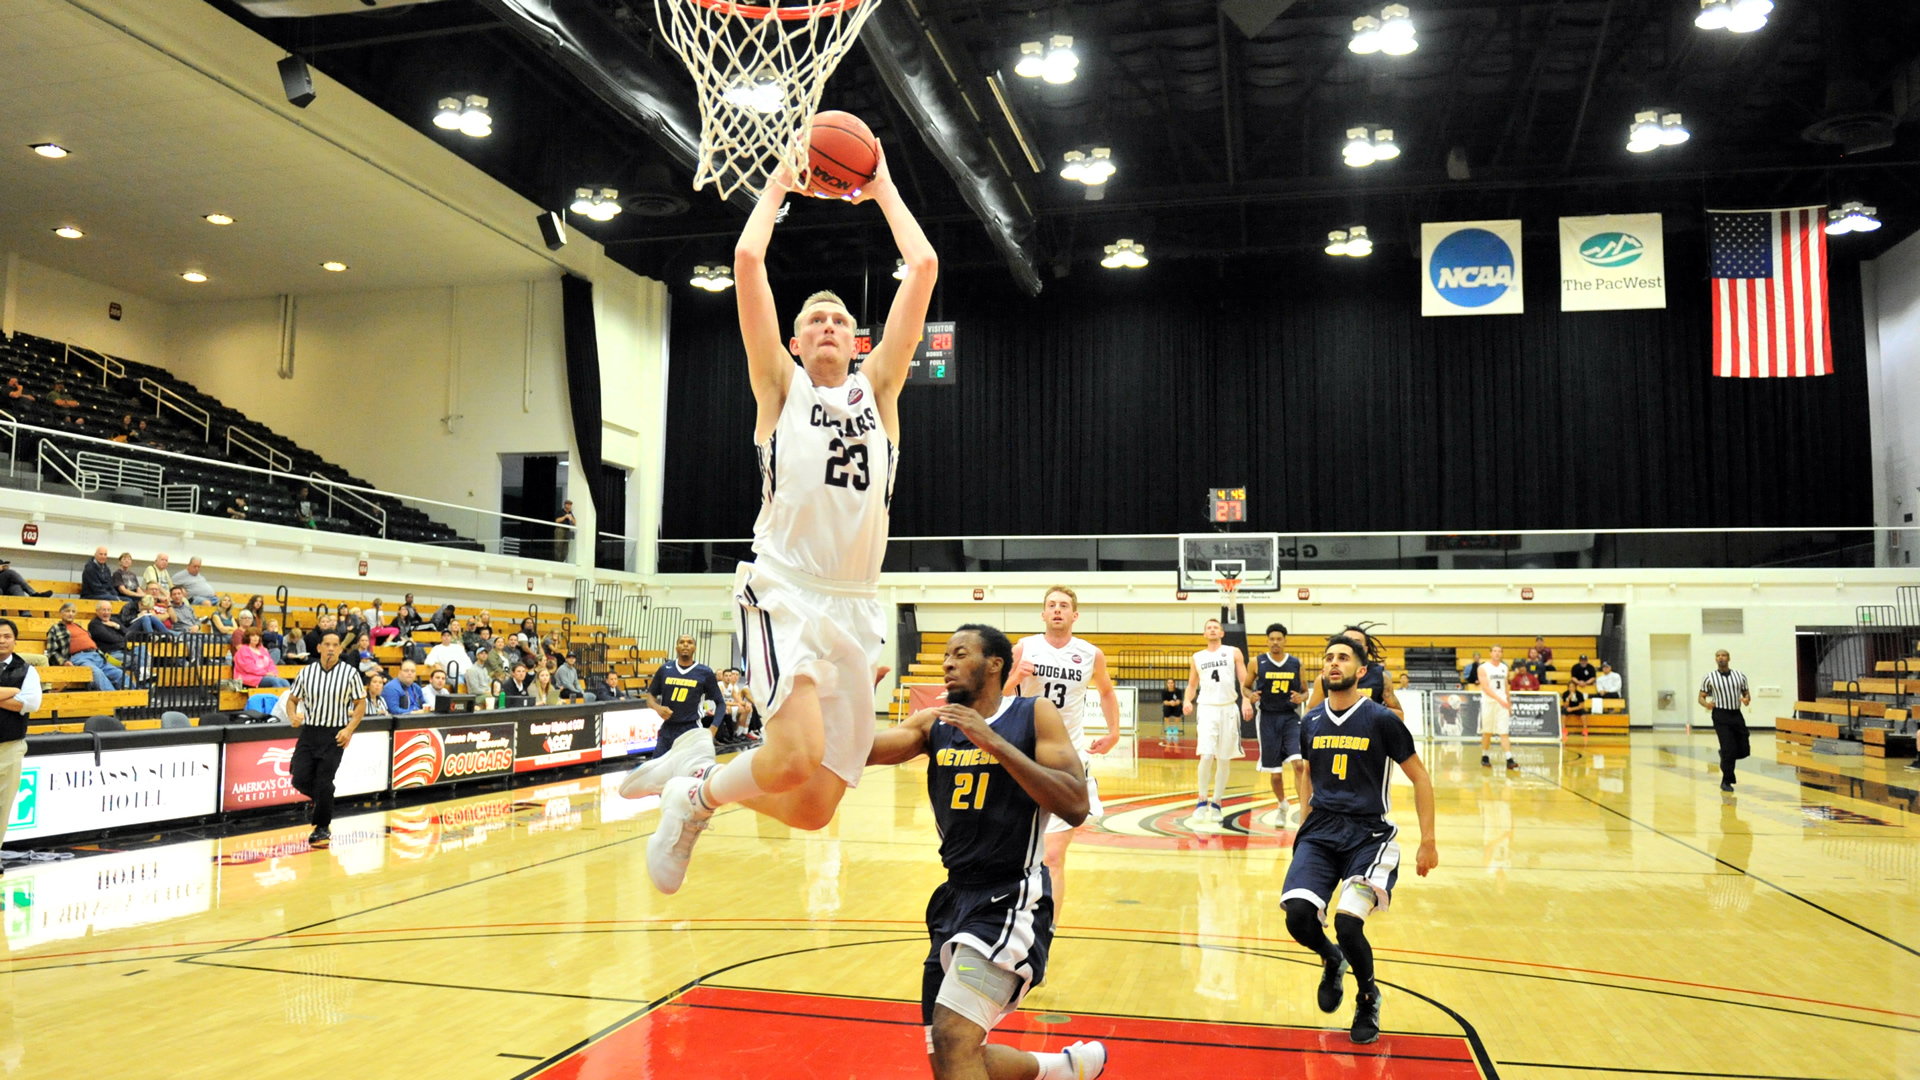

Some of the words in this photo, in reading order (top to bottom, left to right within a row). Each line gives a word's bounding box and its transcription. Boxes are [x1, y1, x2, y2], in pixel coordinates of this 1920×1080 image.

[813, 165, 853, 191] NCAA
[1437, 265, 1512, 289] NCAA
[1563, 279, 1592, 291] The
[1595, 276, 1662, 290] PacWest
[855, 328, 870, 336] OME
[927, 325, 954, 333] VISITOR
[931, 333, 952, 350] 20
[936, 365, 945, 378] 2
[824, 437, 870, 491] 23
[1216, 501, 1242, 521] 27
[23, 531, 37, 541] 103
[1032, 663, 1082, 682] COUGARS
[1201, 660, 1227, 670] COUGARS
[1211, 669, 1220, 683] 4
[670, 687, 689, 702] 10
[1044, 682, 1067, 709] 13
[1271, 680, 1289, 694] 24
[444, 748, 513, 777] COUGARS
[936, 748, 1000, 766] BETHES
[1332, 753, 1348, 780] 4
[232, 778, 276, 795] AMERICA'S
[950, 772, 990, 810] 21
[238, 790, 276, 802] CREDIT
